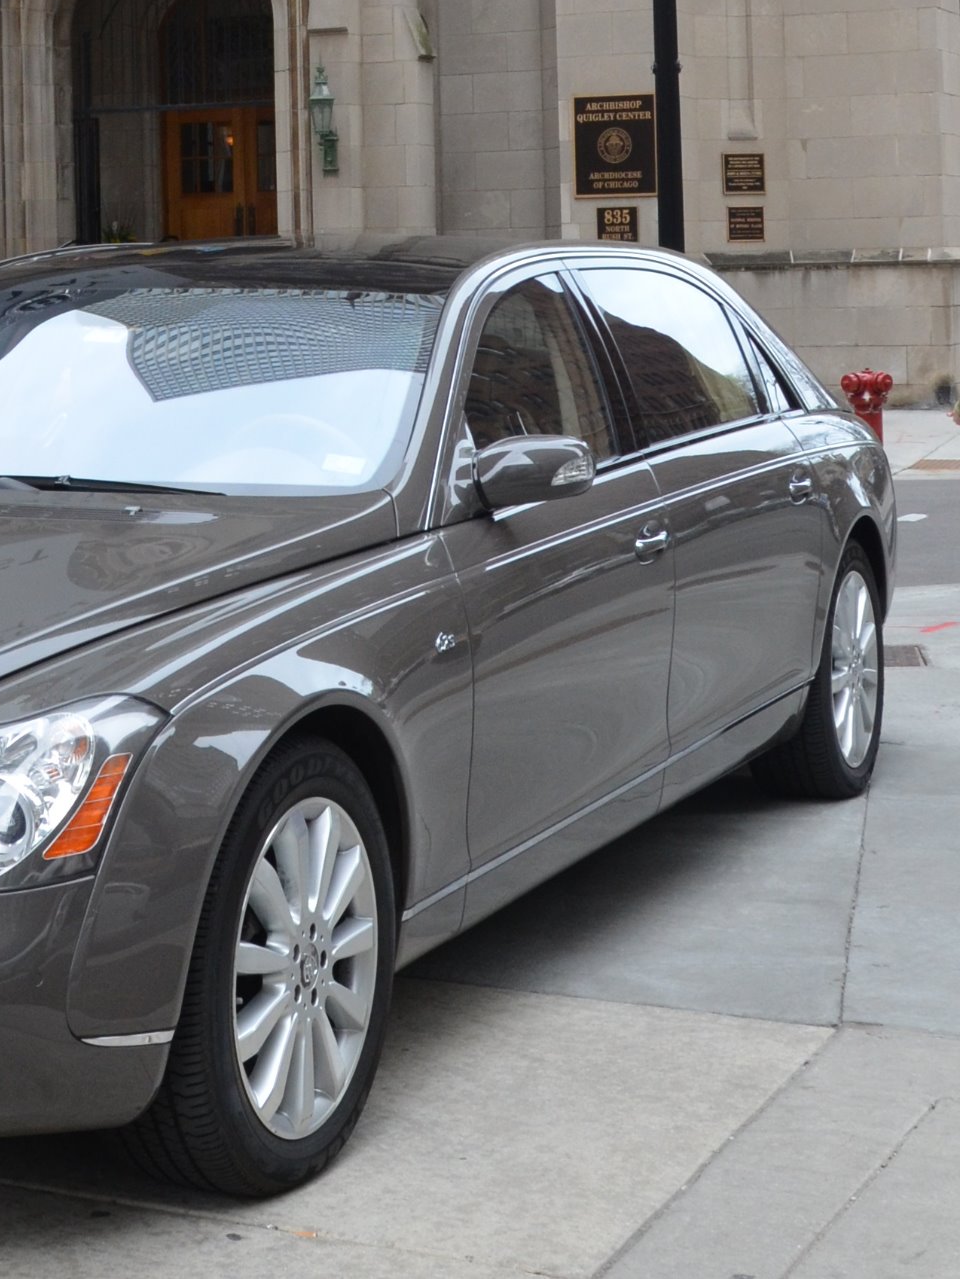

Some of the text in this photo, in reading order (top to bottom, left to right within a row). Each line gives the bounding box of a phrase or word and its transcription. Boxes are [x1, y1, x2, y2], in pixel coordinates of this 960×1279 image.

[585, 100, 642, 111] ARCHBISHOP
[576, 111, 652, 123] QUIGLEY CENTER
[589, 170, 642, 180] ARCHDIOCESE
[593, 180, 639, 189] OF CHICAGO
[604, 209, 631, 225] 835
[605, 225, 630, 233] NORTH
